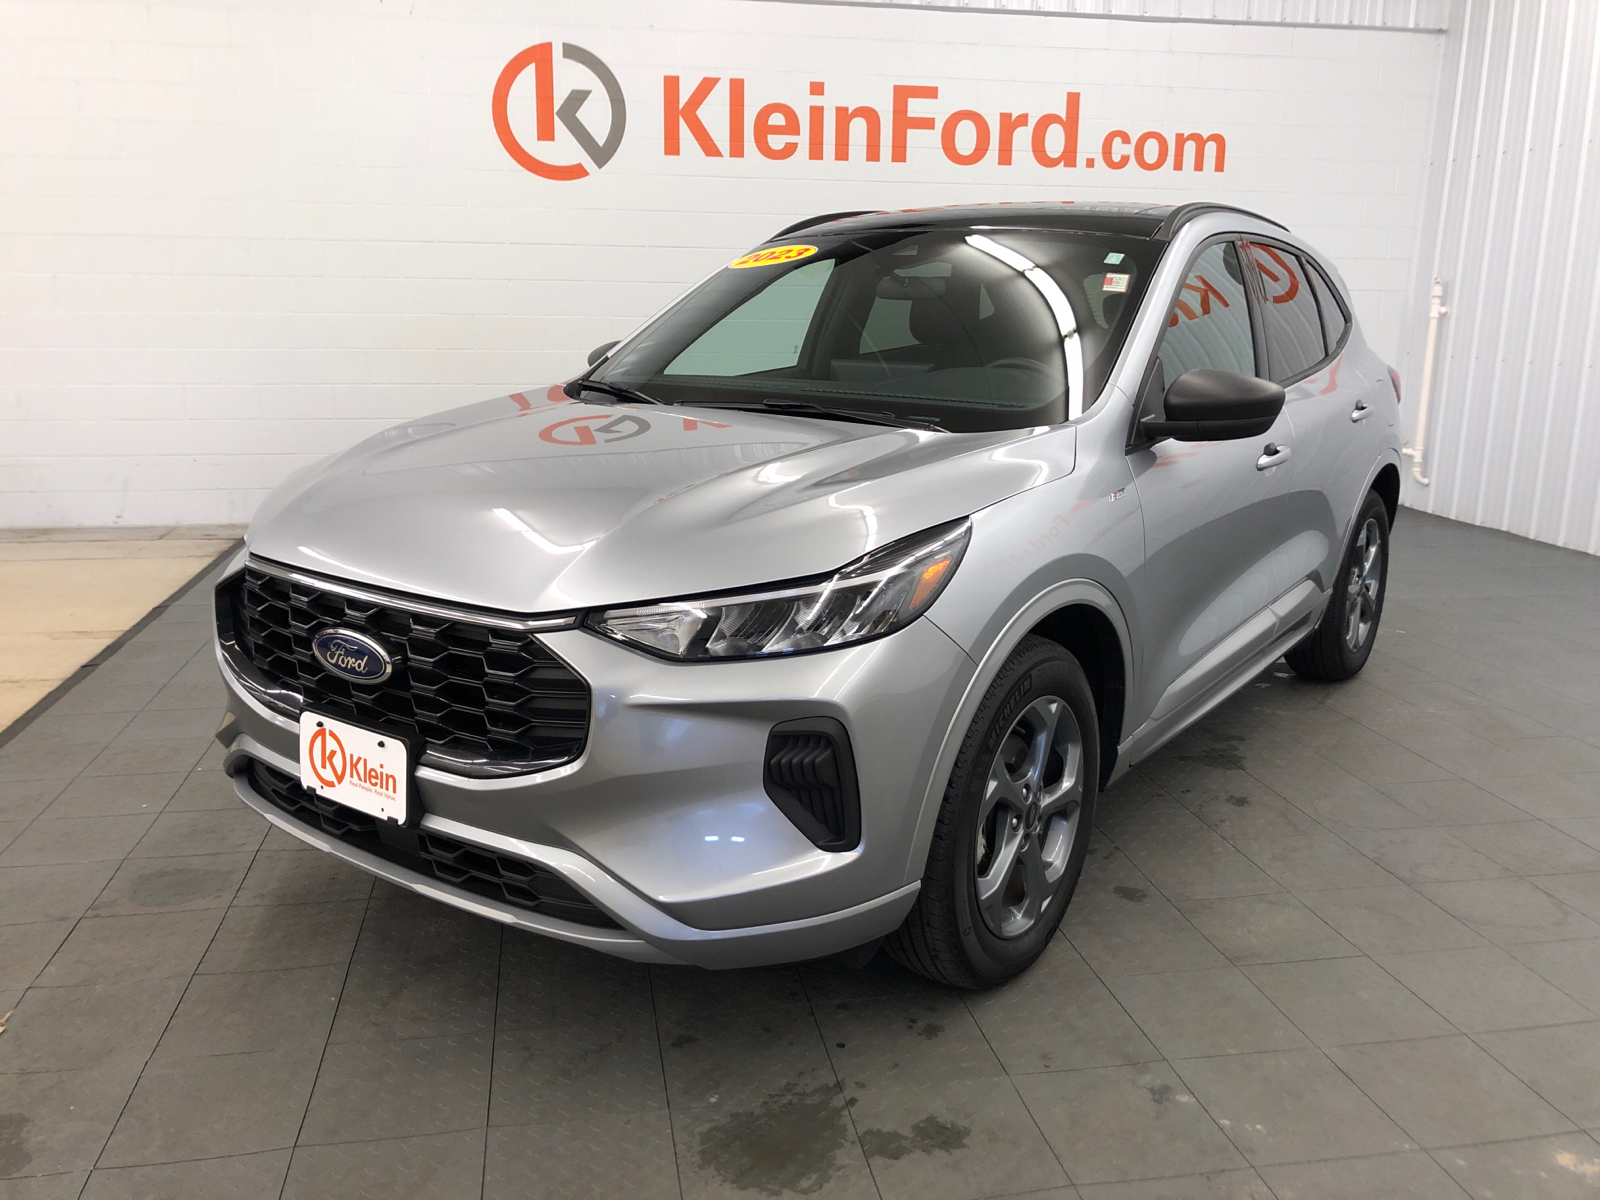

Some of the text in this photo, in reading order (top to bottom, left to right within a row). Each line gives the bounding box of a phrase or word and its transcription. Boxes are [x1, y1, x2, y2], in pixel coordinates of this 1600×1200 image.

[663, 75, 1226, 173] KleinFord.com
[735, 248, 811, 265] 2023
[326, 639, 369, 673] Ford
[988, 677, 1032, 750] MICHELIN
[349, 753, 397, 794] Klein
[349, 779, 396, 801] Real People. Real Value.
